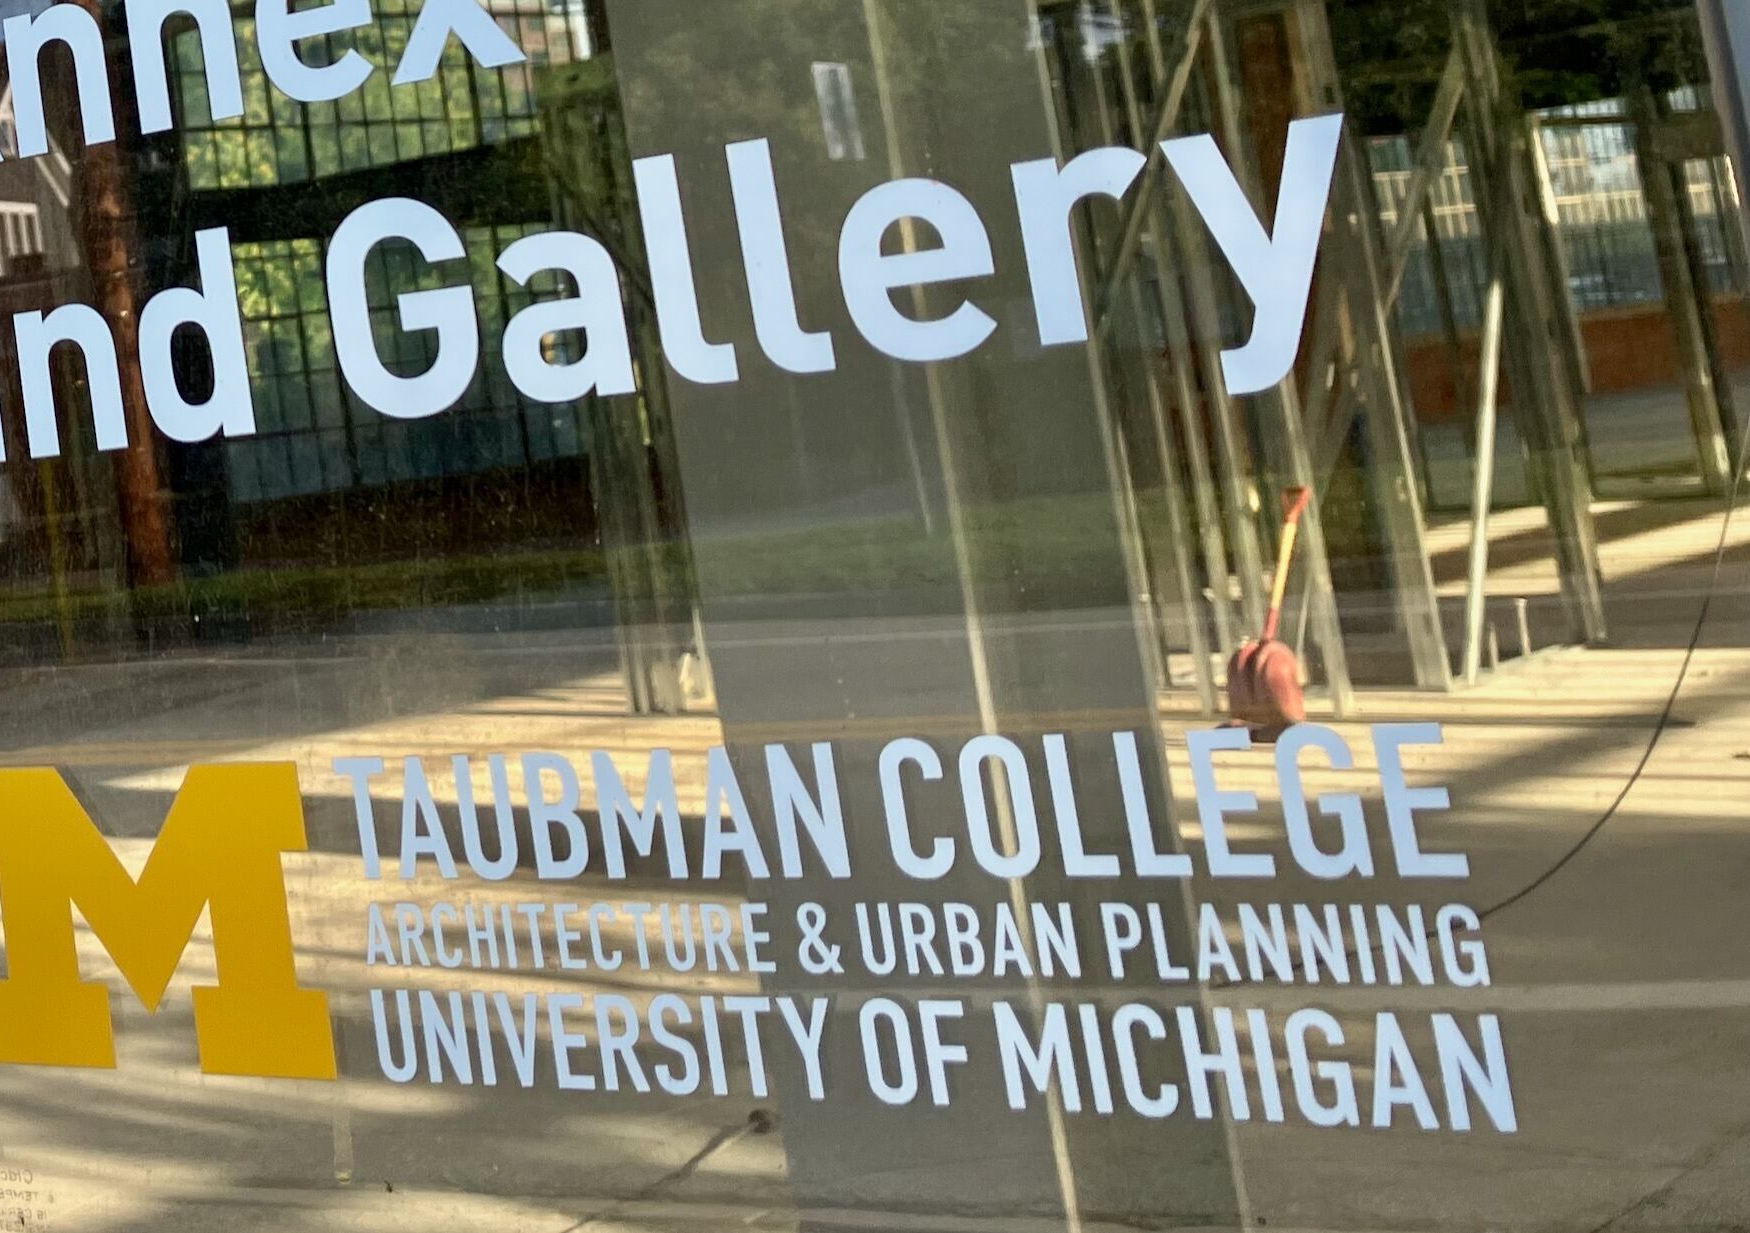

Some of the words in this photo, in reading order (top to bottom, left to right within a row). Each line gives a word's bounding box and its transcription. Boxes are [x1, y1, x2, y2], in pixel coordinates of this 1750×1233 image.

[326, 114, 1342, 421] Gallery
[333, 740, 854, 884] TAUBMAN
[879, 721, 1470, 882] COLLEGE
[364, 902, 774, 975] ARCHITECTURE
[797, 904, 844, 975] &
[860, 902, 1084, 981] URBAN
[1104, 902, 1492, 988] PLANNING
[370, 988, 831, 1100] UNIVERSITY
[859, 997, 969, 1106] OF
[991, 998, 1518, 1134] MICHIGAN
